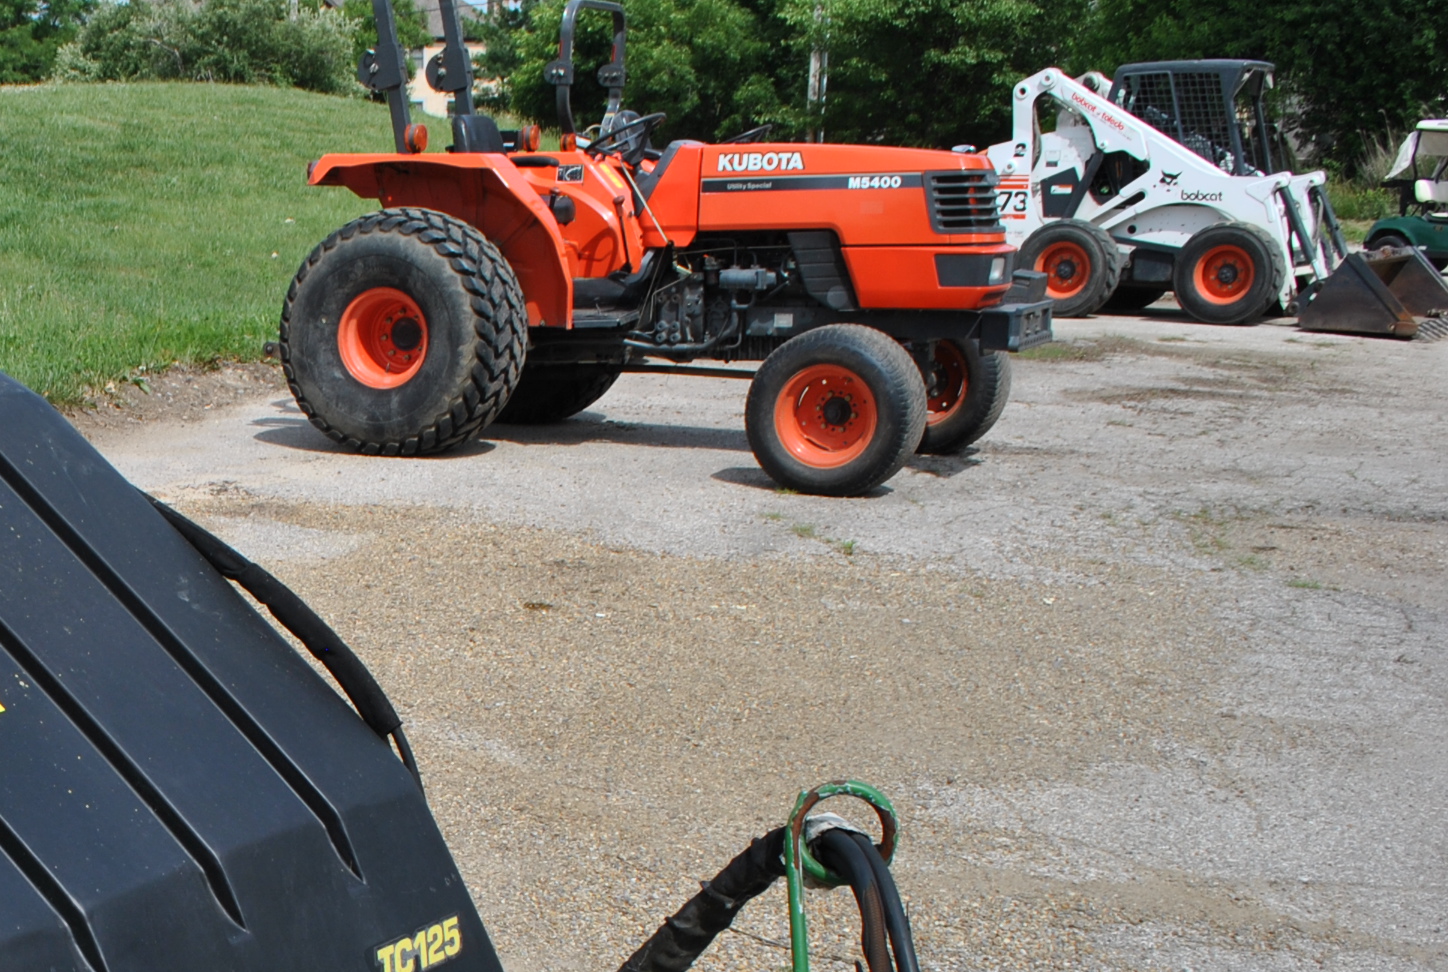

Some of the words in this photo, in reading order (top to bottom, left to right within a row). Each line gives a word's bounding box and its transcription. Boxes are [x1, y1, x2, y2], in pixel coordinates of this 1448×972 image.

[1101, 112, 1125, 131] toledo
[1013, 143, 1027, 158] 2
[717, 152, 805, 172] KUBOTA
[747, 182, 773, 190] Special
[848, 175, 902, 190] M5400
[1180, 189, 1223, 202] bobcat
